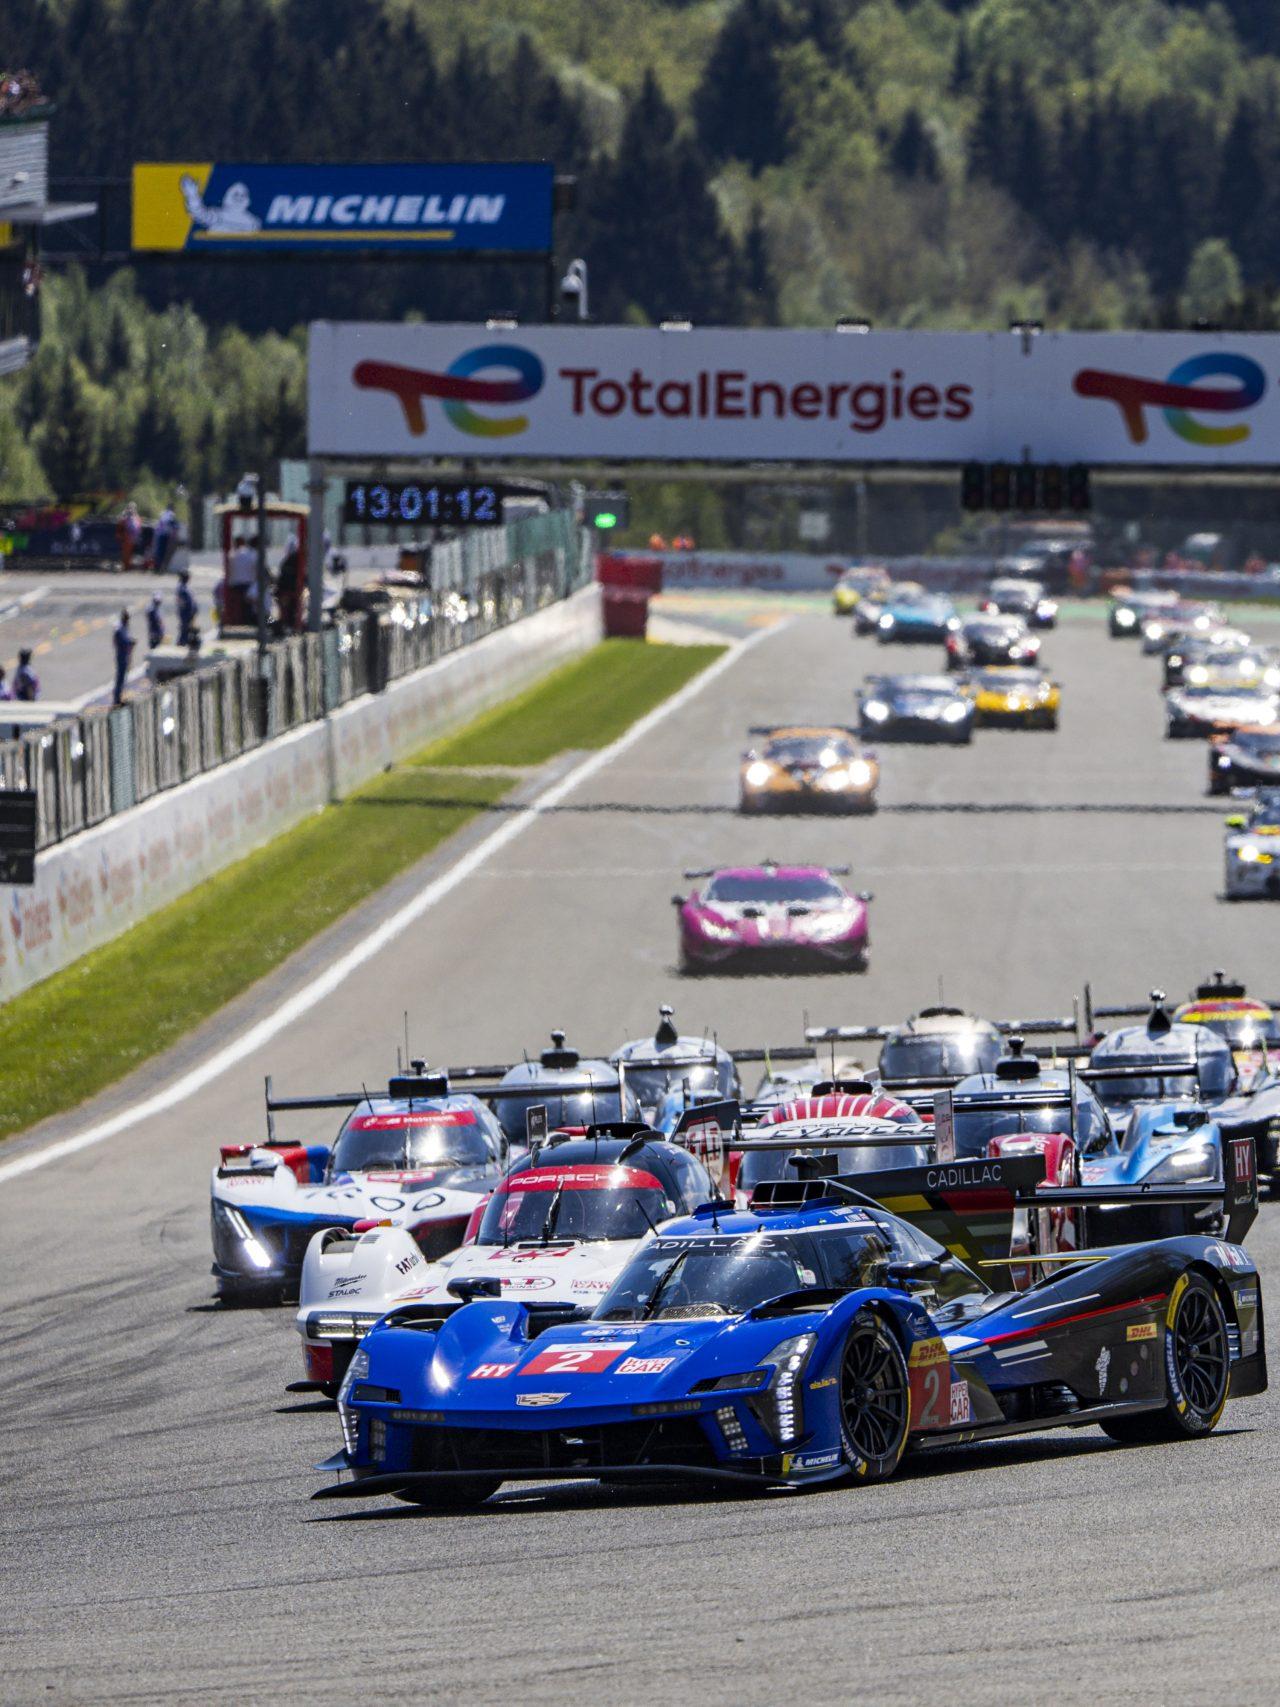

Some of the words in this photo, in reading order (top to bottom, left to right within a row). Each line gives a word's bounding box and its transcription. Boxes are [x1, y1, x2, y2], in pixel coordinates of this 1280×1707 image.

[265, 194, 506, 225] MICHELIN
[558, 366, 974, 434] TotalEnergies
[349, 485, 498, 522] 13:01:12
[1235, 1145, 1250, 1178] HY
[508, 1172, 630, 1187] PORSCH
[926, 1163, 1003, 1189] CADILLAC
[646, 1237, 776, 1250] ADILLAC
[1130, 1326, 1153, 1338] DHL
[544, 1350, 594, 1373] 2
[919, 1343, 945, 1361] DHL
[469, 1363, 512, 1378] HY
[619, 1362, 668, 1374] CAR
[919, 1369, 941, 1425] 2
[951, 1397, 969, 1421] CAR
[805, 1454, 839, 1466] MICHELIN
